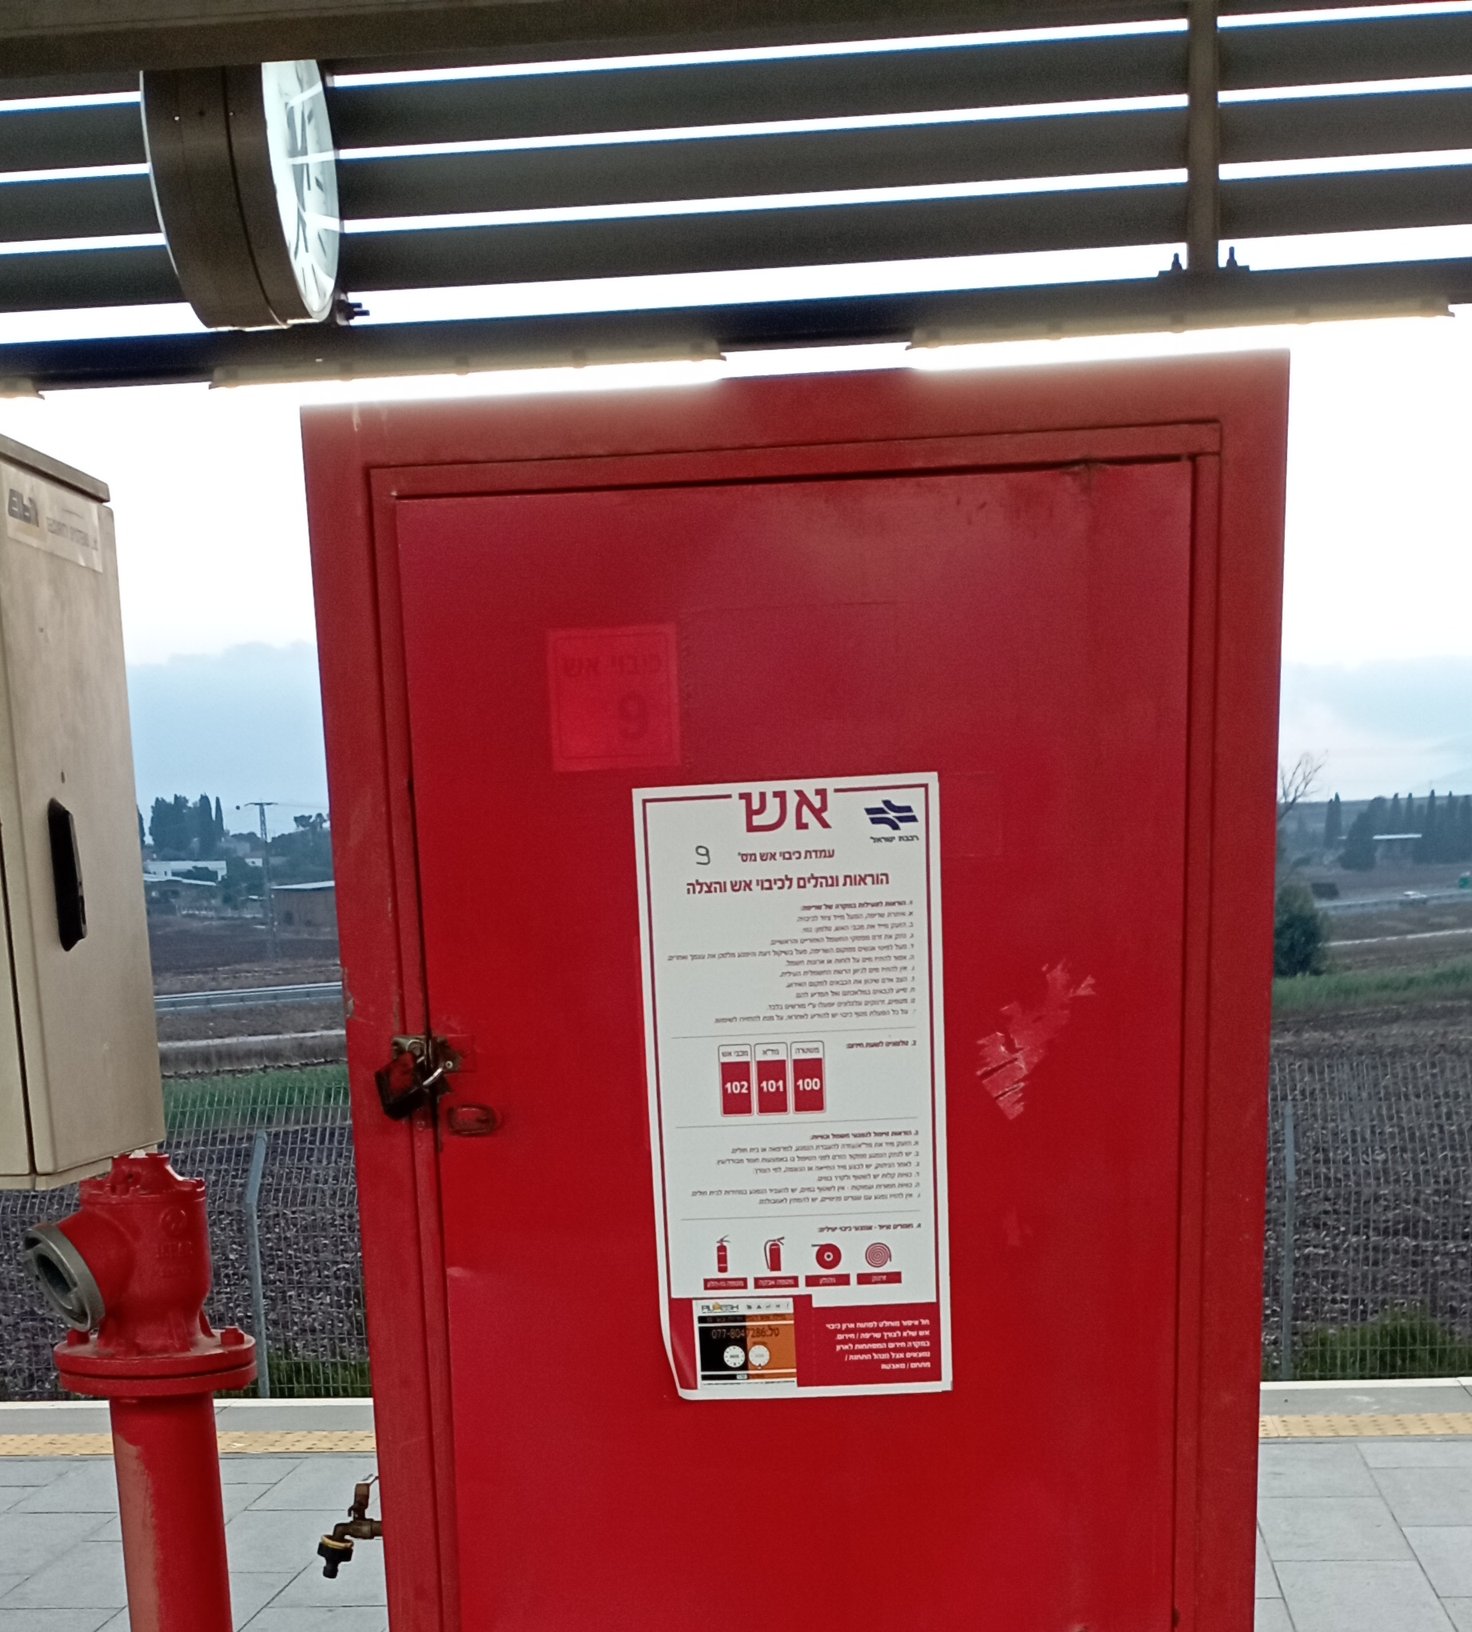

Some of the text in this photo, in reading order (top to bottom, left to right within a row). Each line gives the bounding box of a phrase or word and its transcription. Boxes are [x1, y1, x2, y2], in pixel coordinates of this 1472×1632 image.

[562, 656, 601, 678] אש
[617, 689, 649, 740] 9
[738, 787, 833, 833] אש
[869, 834, 920, 843] רכבת ישראל
[695, 845, 711, 866] 9
[758, 851, 777, 861] אש
[778, 850, 802, 860] כיבוי
[803, 848, 835, 859] עמדת
[685, 872, 889, 894] הוראות ונהלים לכיבוי אש והצלה
[725, 1081, 749, 1093] 102
[760, 1079, 784, 1092] 101
[796, 1077, 821, 1091] 100
[841, 1322, 855, 1330] ארון
[855, 1320, 878, 1328] לפתוח
[859, 1331, 882, 1339] שריפה
[882, 1330, 901, 1339] לצורך
[901, 1329, 918, 1337] שלא
[835, 1342, 853, 1351] לארון
[906, 1340, 930, 1348] במקרה
[889, 1351, 905, 1359] אצל
[904, 1350, 931, 1358] נמצאים
